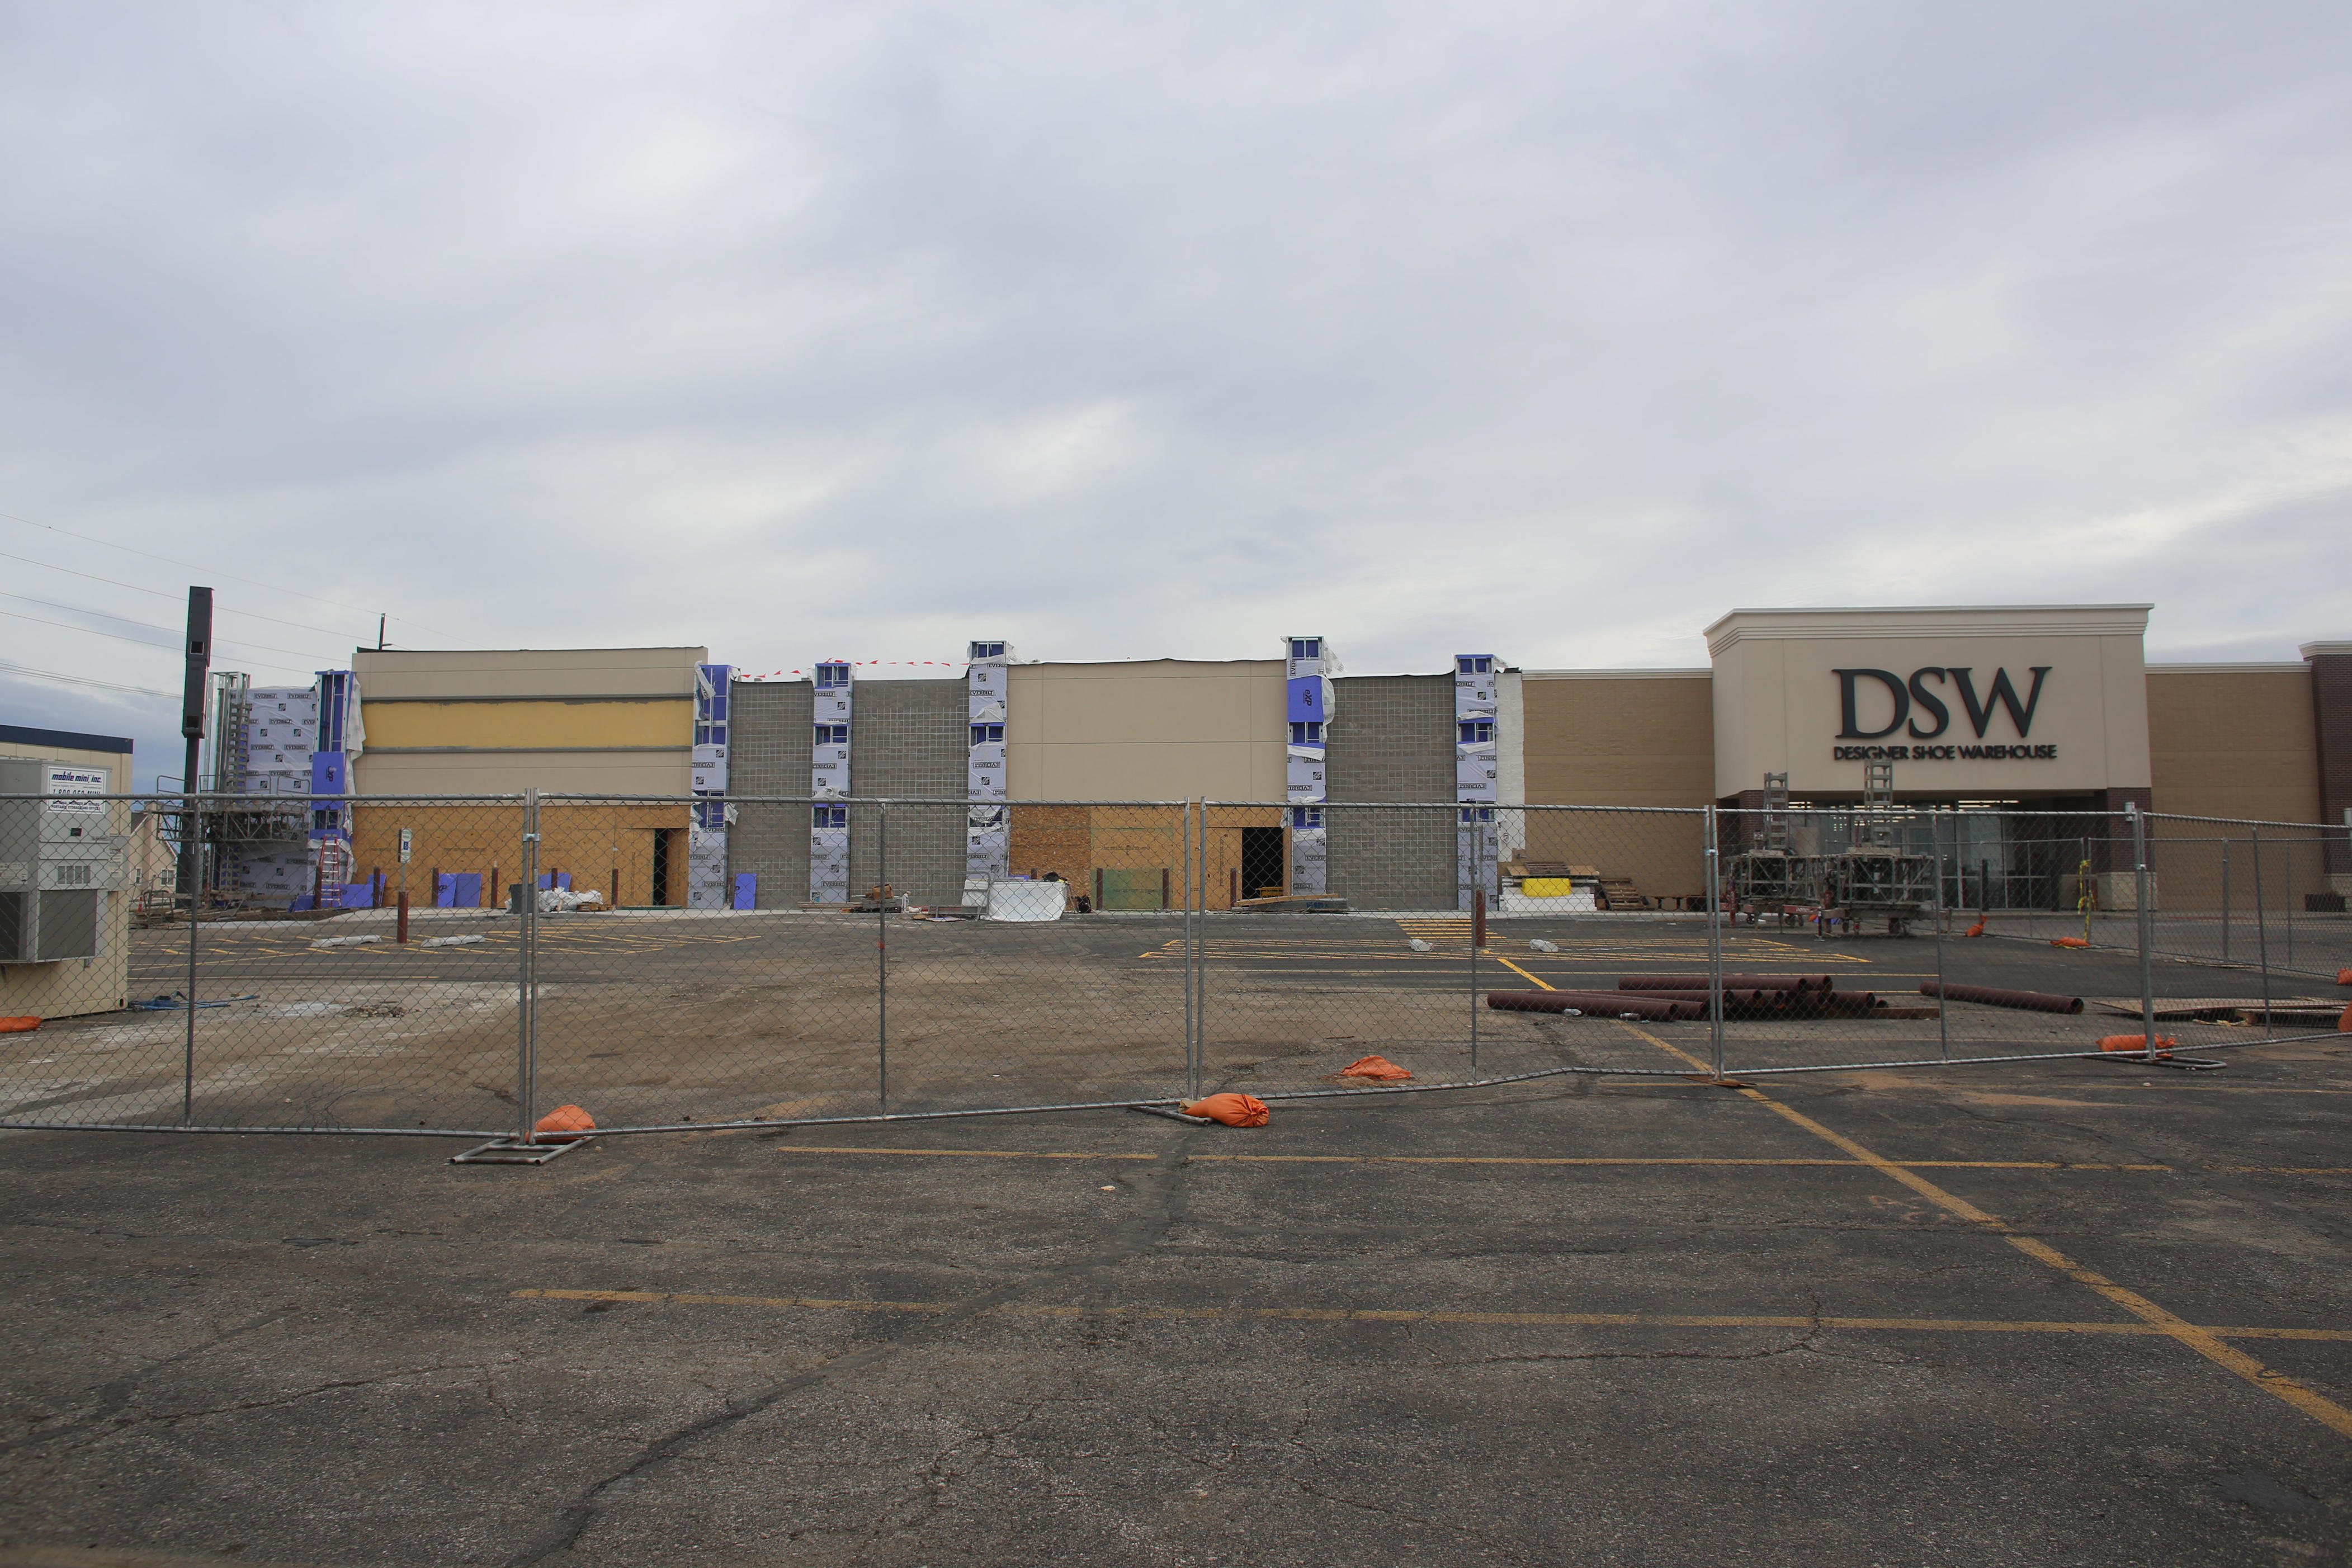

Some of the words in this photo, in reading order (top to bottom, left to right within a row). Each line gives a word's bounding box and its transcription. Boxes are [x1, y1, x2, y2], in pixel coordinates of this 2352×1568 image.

[1831, 667, 2053, 739] DSW
[1834, 746, 1910, 760] DESIGNER
[1912, 745, 1956, 759] SHOE
[1957, 745, 2057, 759] WAREHOUSE
[51, 771, 74, 781] mobile
